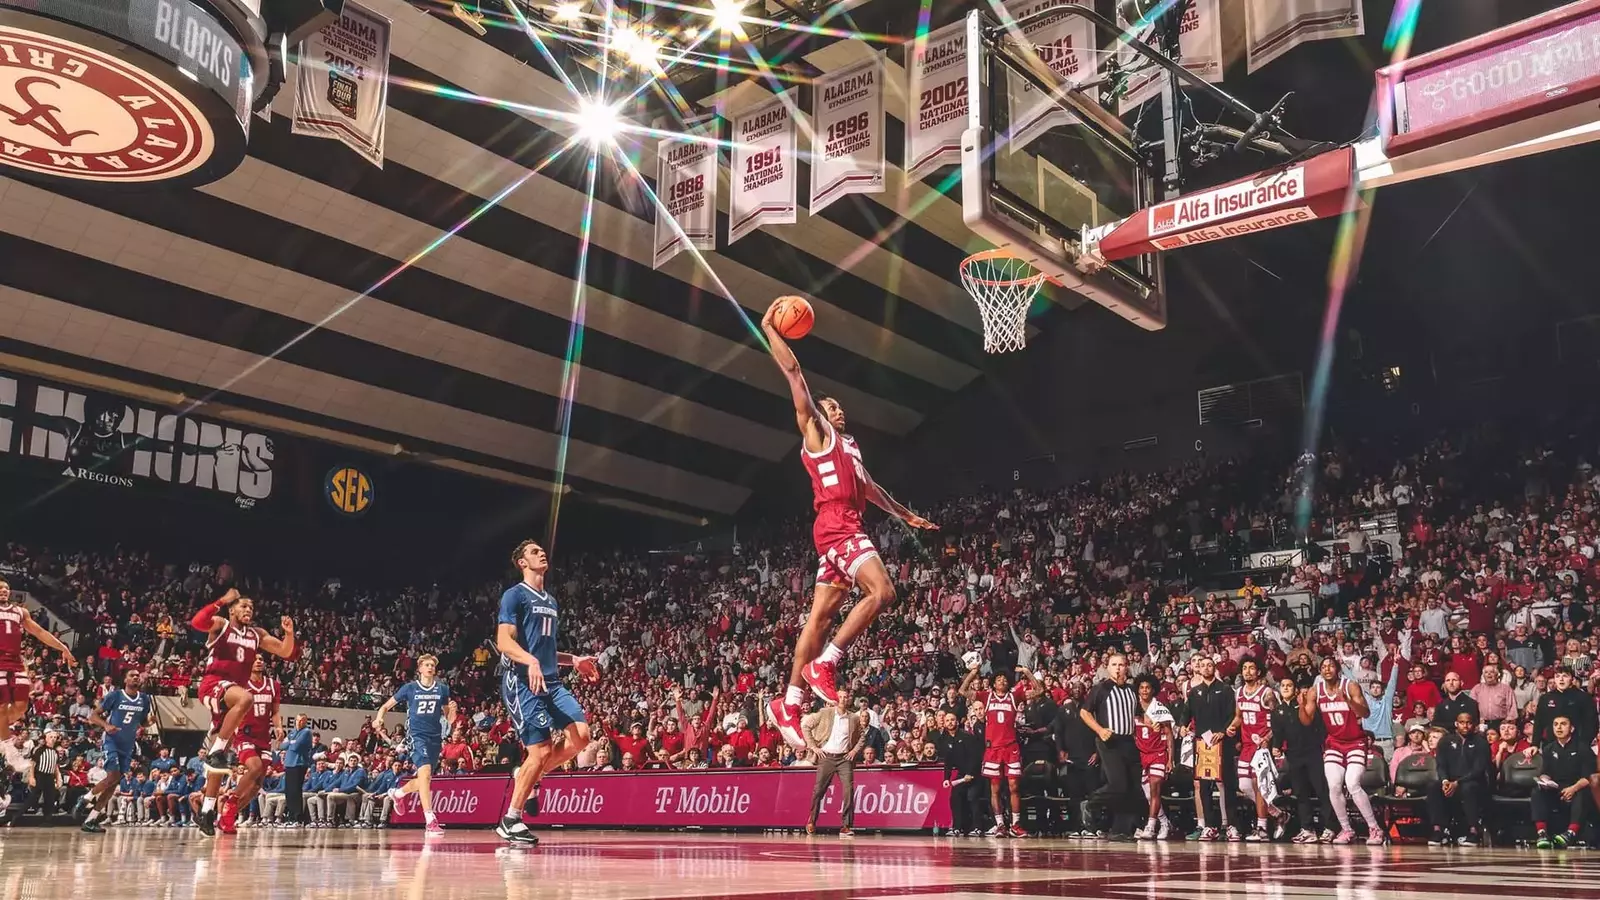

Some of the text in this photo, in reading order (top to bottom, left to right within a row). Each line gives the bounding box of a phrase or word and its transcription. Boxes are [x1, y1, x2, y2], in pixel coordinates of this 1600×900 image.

[333, 15, 377, 44] ABAMA
[154, 0, 232, 88] BLOCKS
[323, 35, 368, 62] FINAL FOUR
[917, 34, 967, 67] ALABAM
[1039, 34, 1073, 62] 011
[324, 50, 364, 80] 2024
[923, 52, 966, 75] GYMNASTICS
[332, 80, 352, 94] FINAL
[824, 70, 874, 102] ALABAMA
[1452, 59, 1523, 100] GOOD
[332, 88, 351, 102] FOUR
[828, 88, 869, 109] GYMNASTICS
[920, 76, 969, 111] 2002
[742, 106, 787, 135] ALABAMA
[920, 97, 969, 121] NATIONAL
[920, 107, 969, 131] CHAMPIONS
[3, 94, 178, 169] ALABAMA
[746, 123, 783, 142] GYMNASTICS
[826, 111, 869, 142] 1996
[825, 130, 870, 153] NATIONAL
[825, 138, 870, 161] CHAMPIONS
[745, 145, 782, 173] 1991
[743, 163, 783, 185] NATIONAL
[743, 171, 783, 193] CHAMPIONS
[669, 174, 704, 201] 1988
[667, 191, 704, 211] NATIONAL
[1178, 178, 1297, 225] Alfa Insurance
[1187, 209, 1309, 244] Alfa Insurance
[1195, 440, 1202, 451] C
[77, 467, 133, 488] REGIONS
[1014, 470, 1020, 480] B
[331, 468, 370, 512] SEC
[5, 620, 12, 634] 1
[541, 617, 552, 636] 11
[122, 712, 135, 724] 5
[417, 701, 437, 714] 23
[280, 716, 337, 731] LEENDS
[430, 789, 478, 813] Mobile
[540, 787, 604, 814] Mobile
[655, 785, 750, 814] T Mobile
